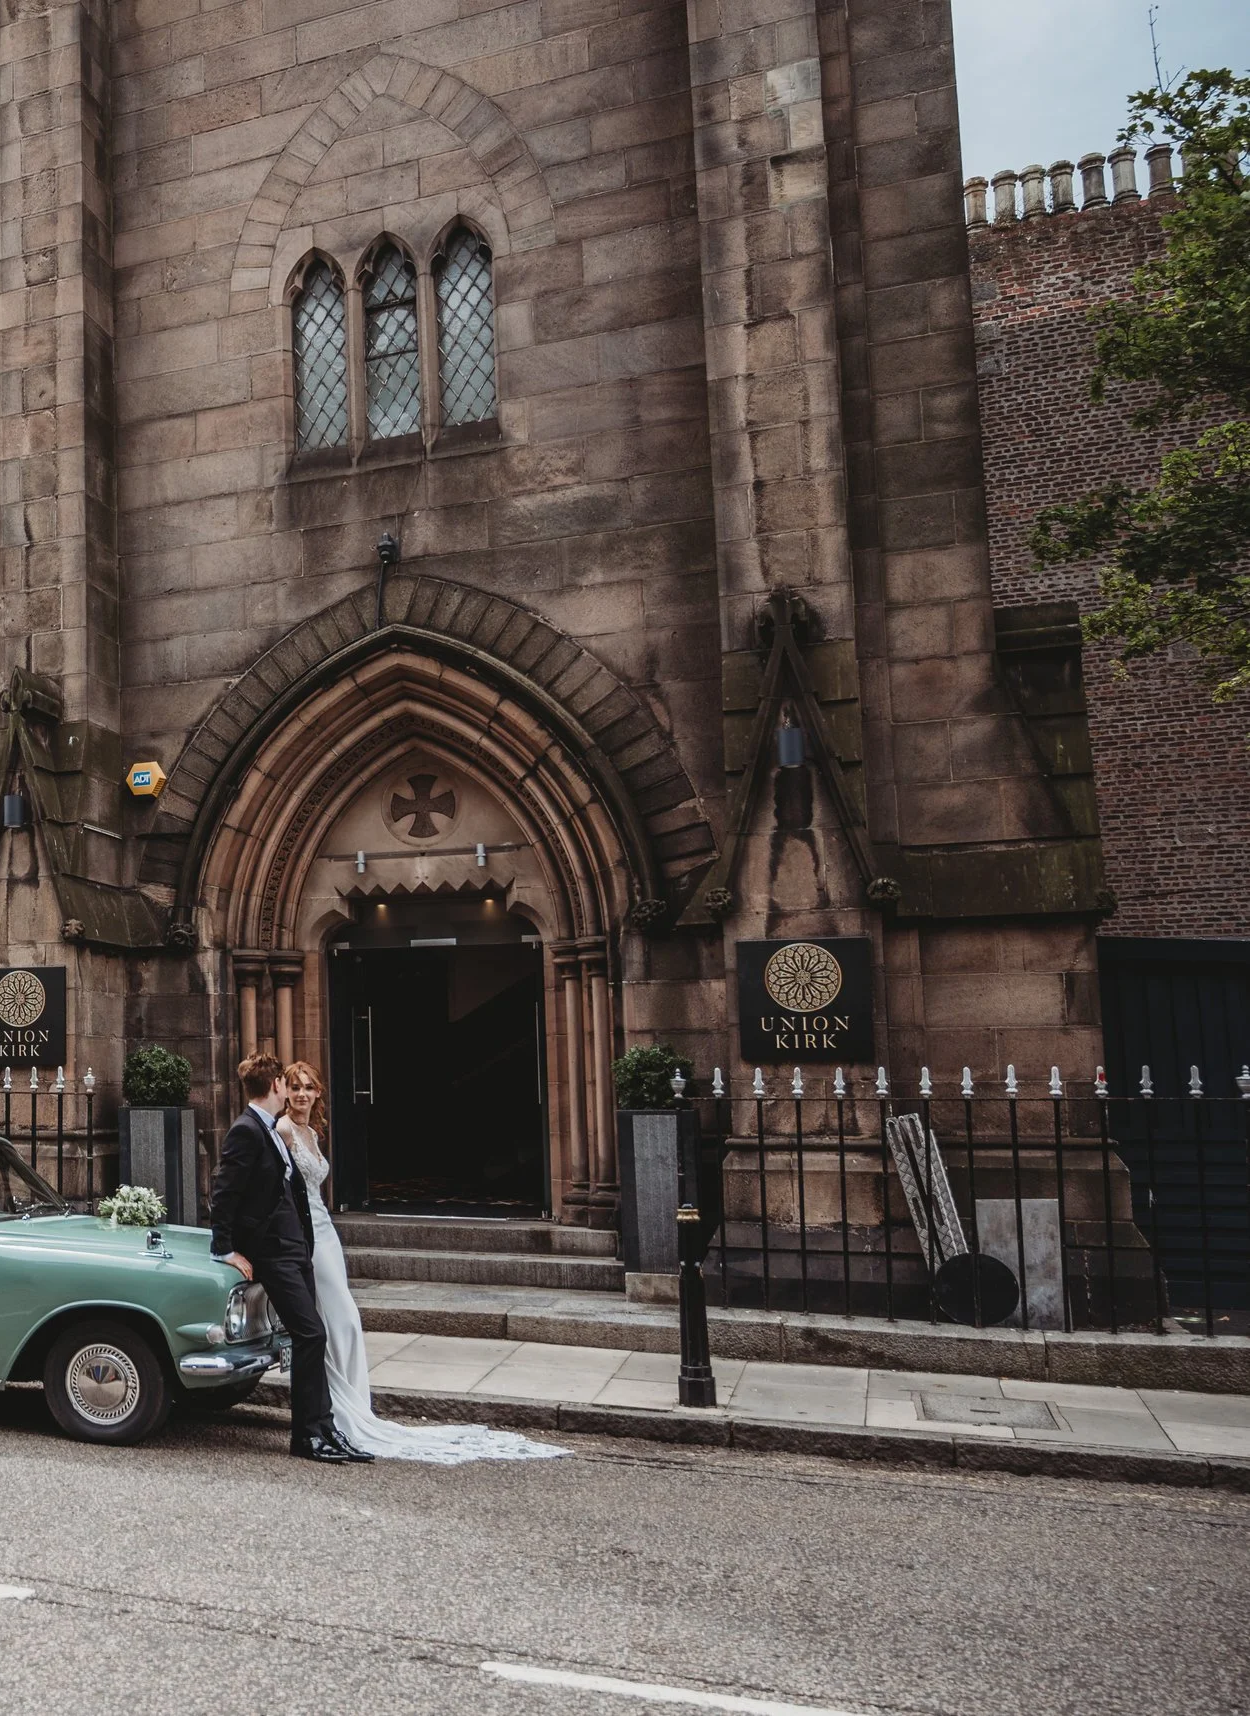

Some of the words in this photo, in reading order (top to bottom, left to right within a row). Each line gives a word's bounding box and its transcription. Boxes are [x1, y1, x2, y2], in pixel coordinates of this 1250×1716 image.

[134, 774, 150, 784] ADT
[760, 1015, 850, 1032] UNION
[775, 1033, 837, 1049] KIRK
[0, 1044, 40, 1057] KIRK
